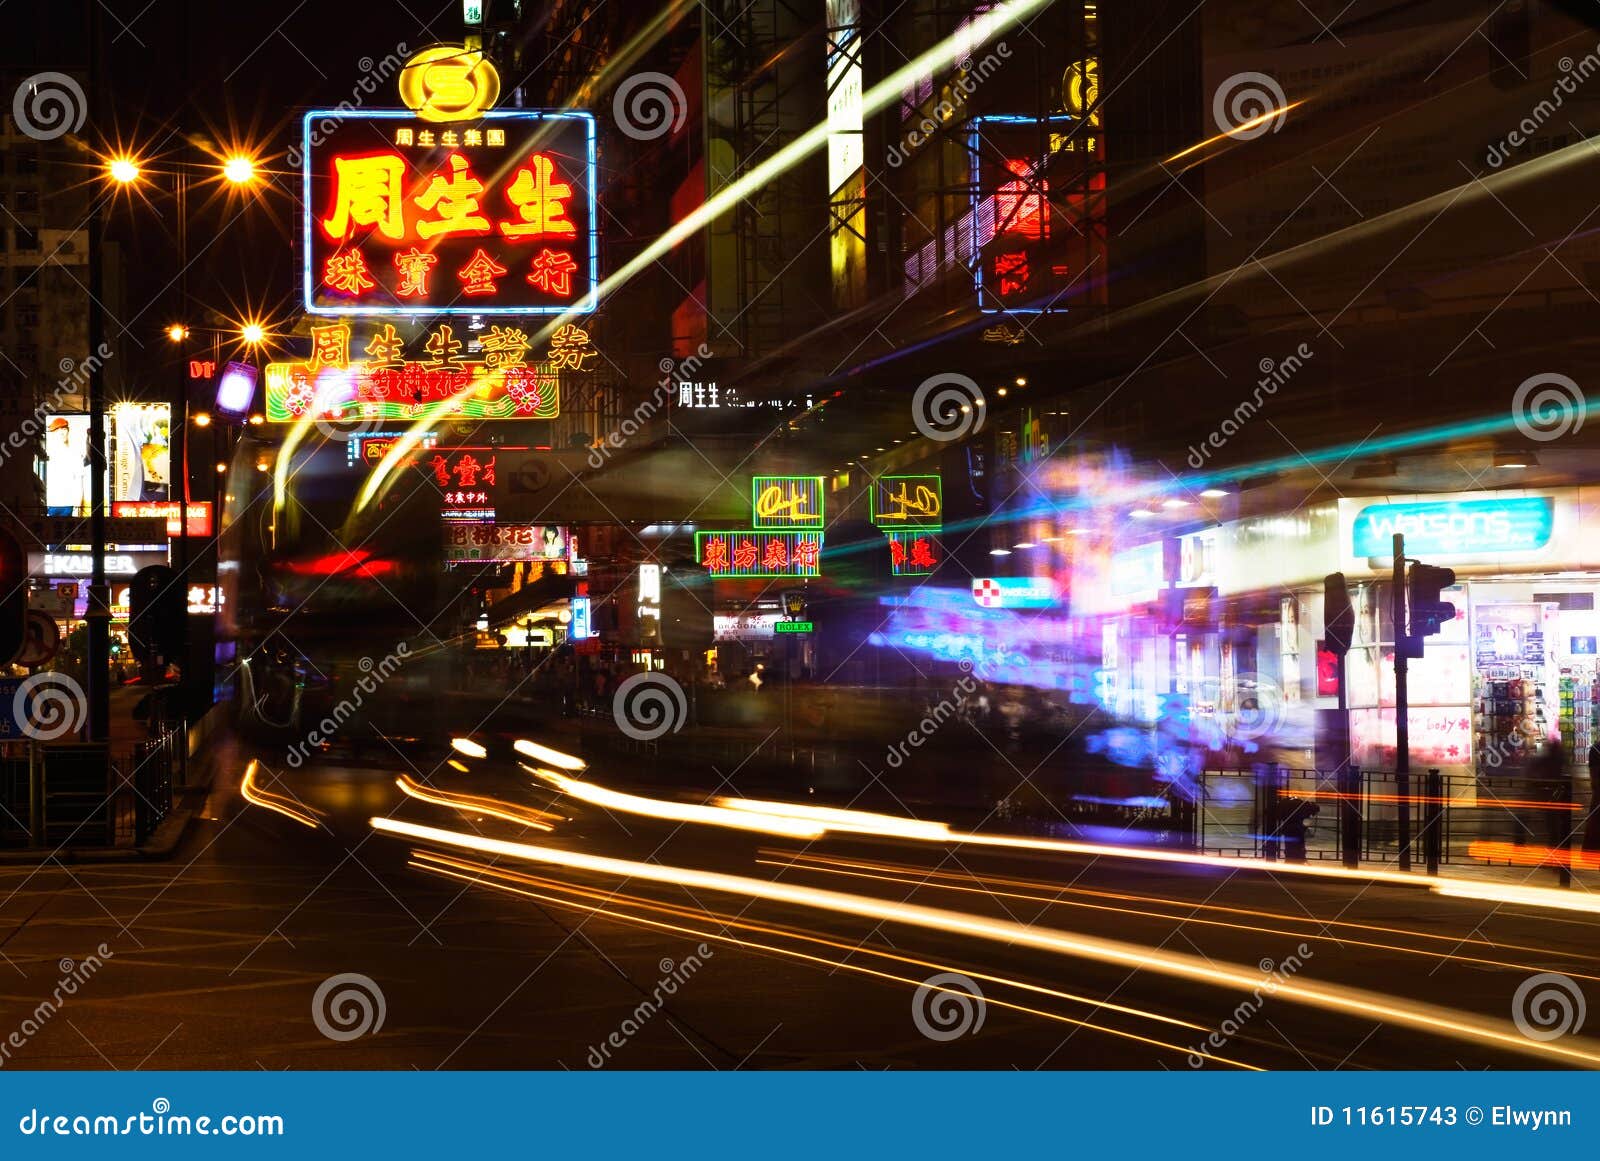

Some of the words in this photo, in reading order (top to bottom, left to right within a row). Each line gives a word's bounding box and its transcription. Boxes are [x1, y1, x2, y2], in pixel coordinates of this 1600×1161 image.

[395, 128, 505, 147] 周生生集團
[323, 153, 577, 241] 周生生
[323, 248, 578, 296] 珠寶金行
[305, 323, 598, 373] 周生生證券
[678, 382, 720, 407] 周生生
[54, 554, 137, 573] KAIER
[702, 538, 820, 570] 東方表行
[779, 623, 811, 631] ROLEX
